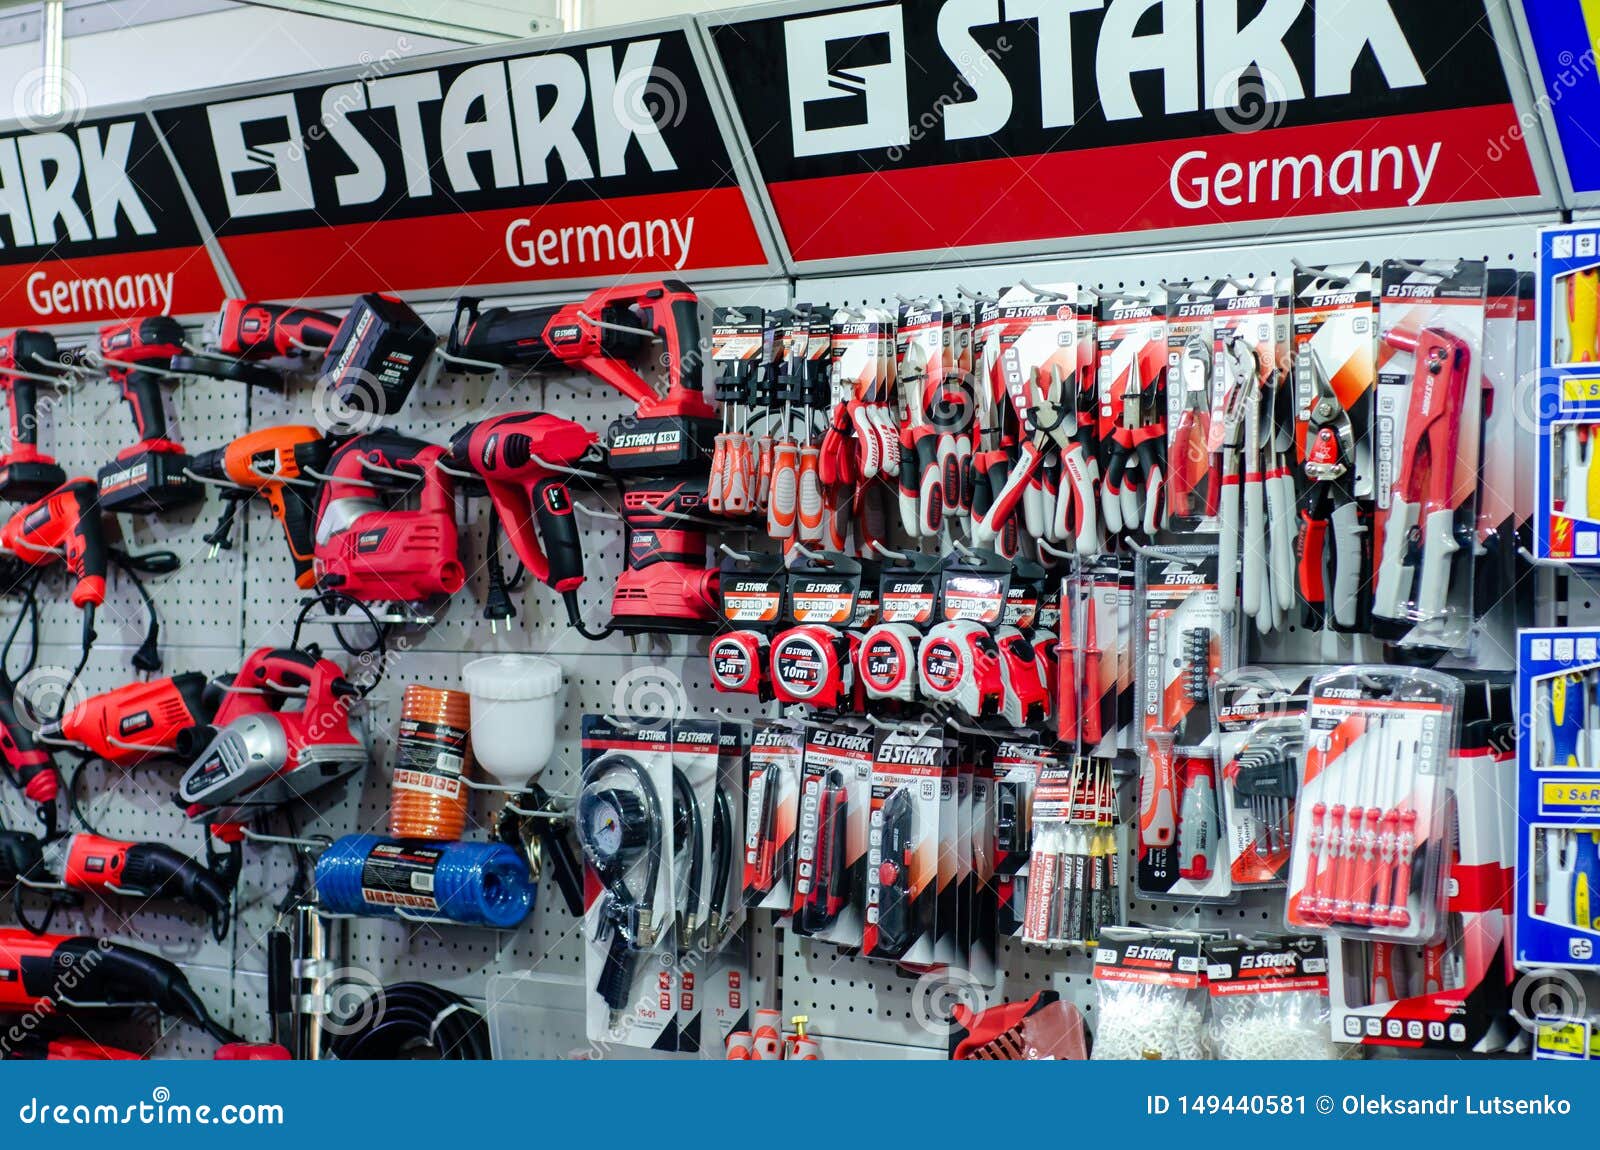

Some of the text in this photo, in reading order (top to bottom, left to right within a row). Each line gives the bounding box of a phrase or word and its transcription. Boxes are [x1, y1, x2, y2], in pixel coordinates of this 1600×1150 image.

[320, 38, 678, 207] STARK
[1170, 141, 1442, 207] Germany
[505, 215, 694, 270] Germany
[27, 271, 174, 316] Germany
[1399, 285, 1437, 297] STARK
[1236, 296, 1262, 308] STARK
[1324, 292, 1357, 306] STARK
[1016, 305, 1049, 318] STARK
[1124, 306, 1154, 319] STARK
[1190, 303, 1214, 316] STAR
[913, 314, 932, 326] STARK
[560, 328, 578, 338] STARK
[849, 324, 870, 333] STARK
[1421, 384, 1434, 417] STARK
[624, 432, 677, 447] STARK 18V
[871, 434, 879, 467] STARK
[1175, 574, 1207, 584] STARK
[744, 583, 769, 592] STARK
[815, 584, 841, 592] STARK
[901, 583, 924, 593] STARK
[793, 647, 814, 657] STARK
[718, 661, 736, 674] 5m
[783, 666, 808, 679] 10m
[871, 661, 888, 673] 5m
[930, 662, 946, 675] 5m
[1332, 688, 1362, 699] STARK
[1231, 705, 1260, 715] STARK
[646, 730, 666, 742] STARK
[686, 732, 714, 744] STARK
[827, 732, 872, 752] STARK
[891, 746, 938, 766] STARK
[1047, 770, 1070, 779] STARK
[1064, 866, 1072, 890] STARK
[1075, 866, 1084, 890] STARK
[1038, 857, 1054, 938] КРЕЙДА ВОСКОВА
[1137, 946, 1176, 961] STARK
[1255, 951, 1297, 967] STARK
